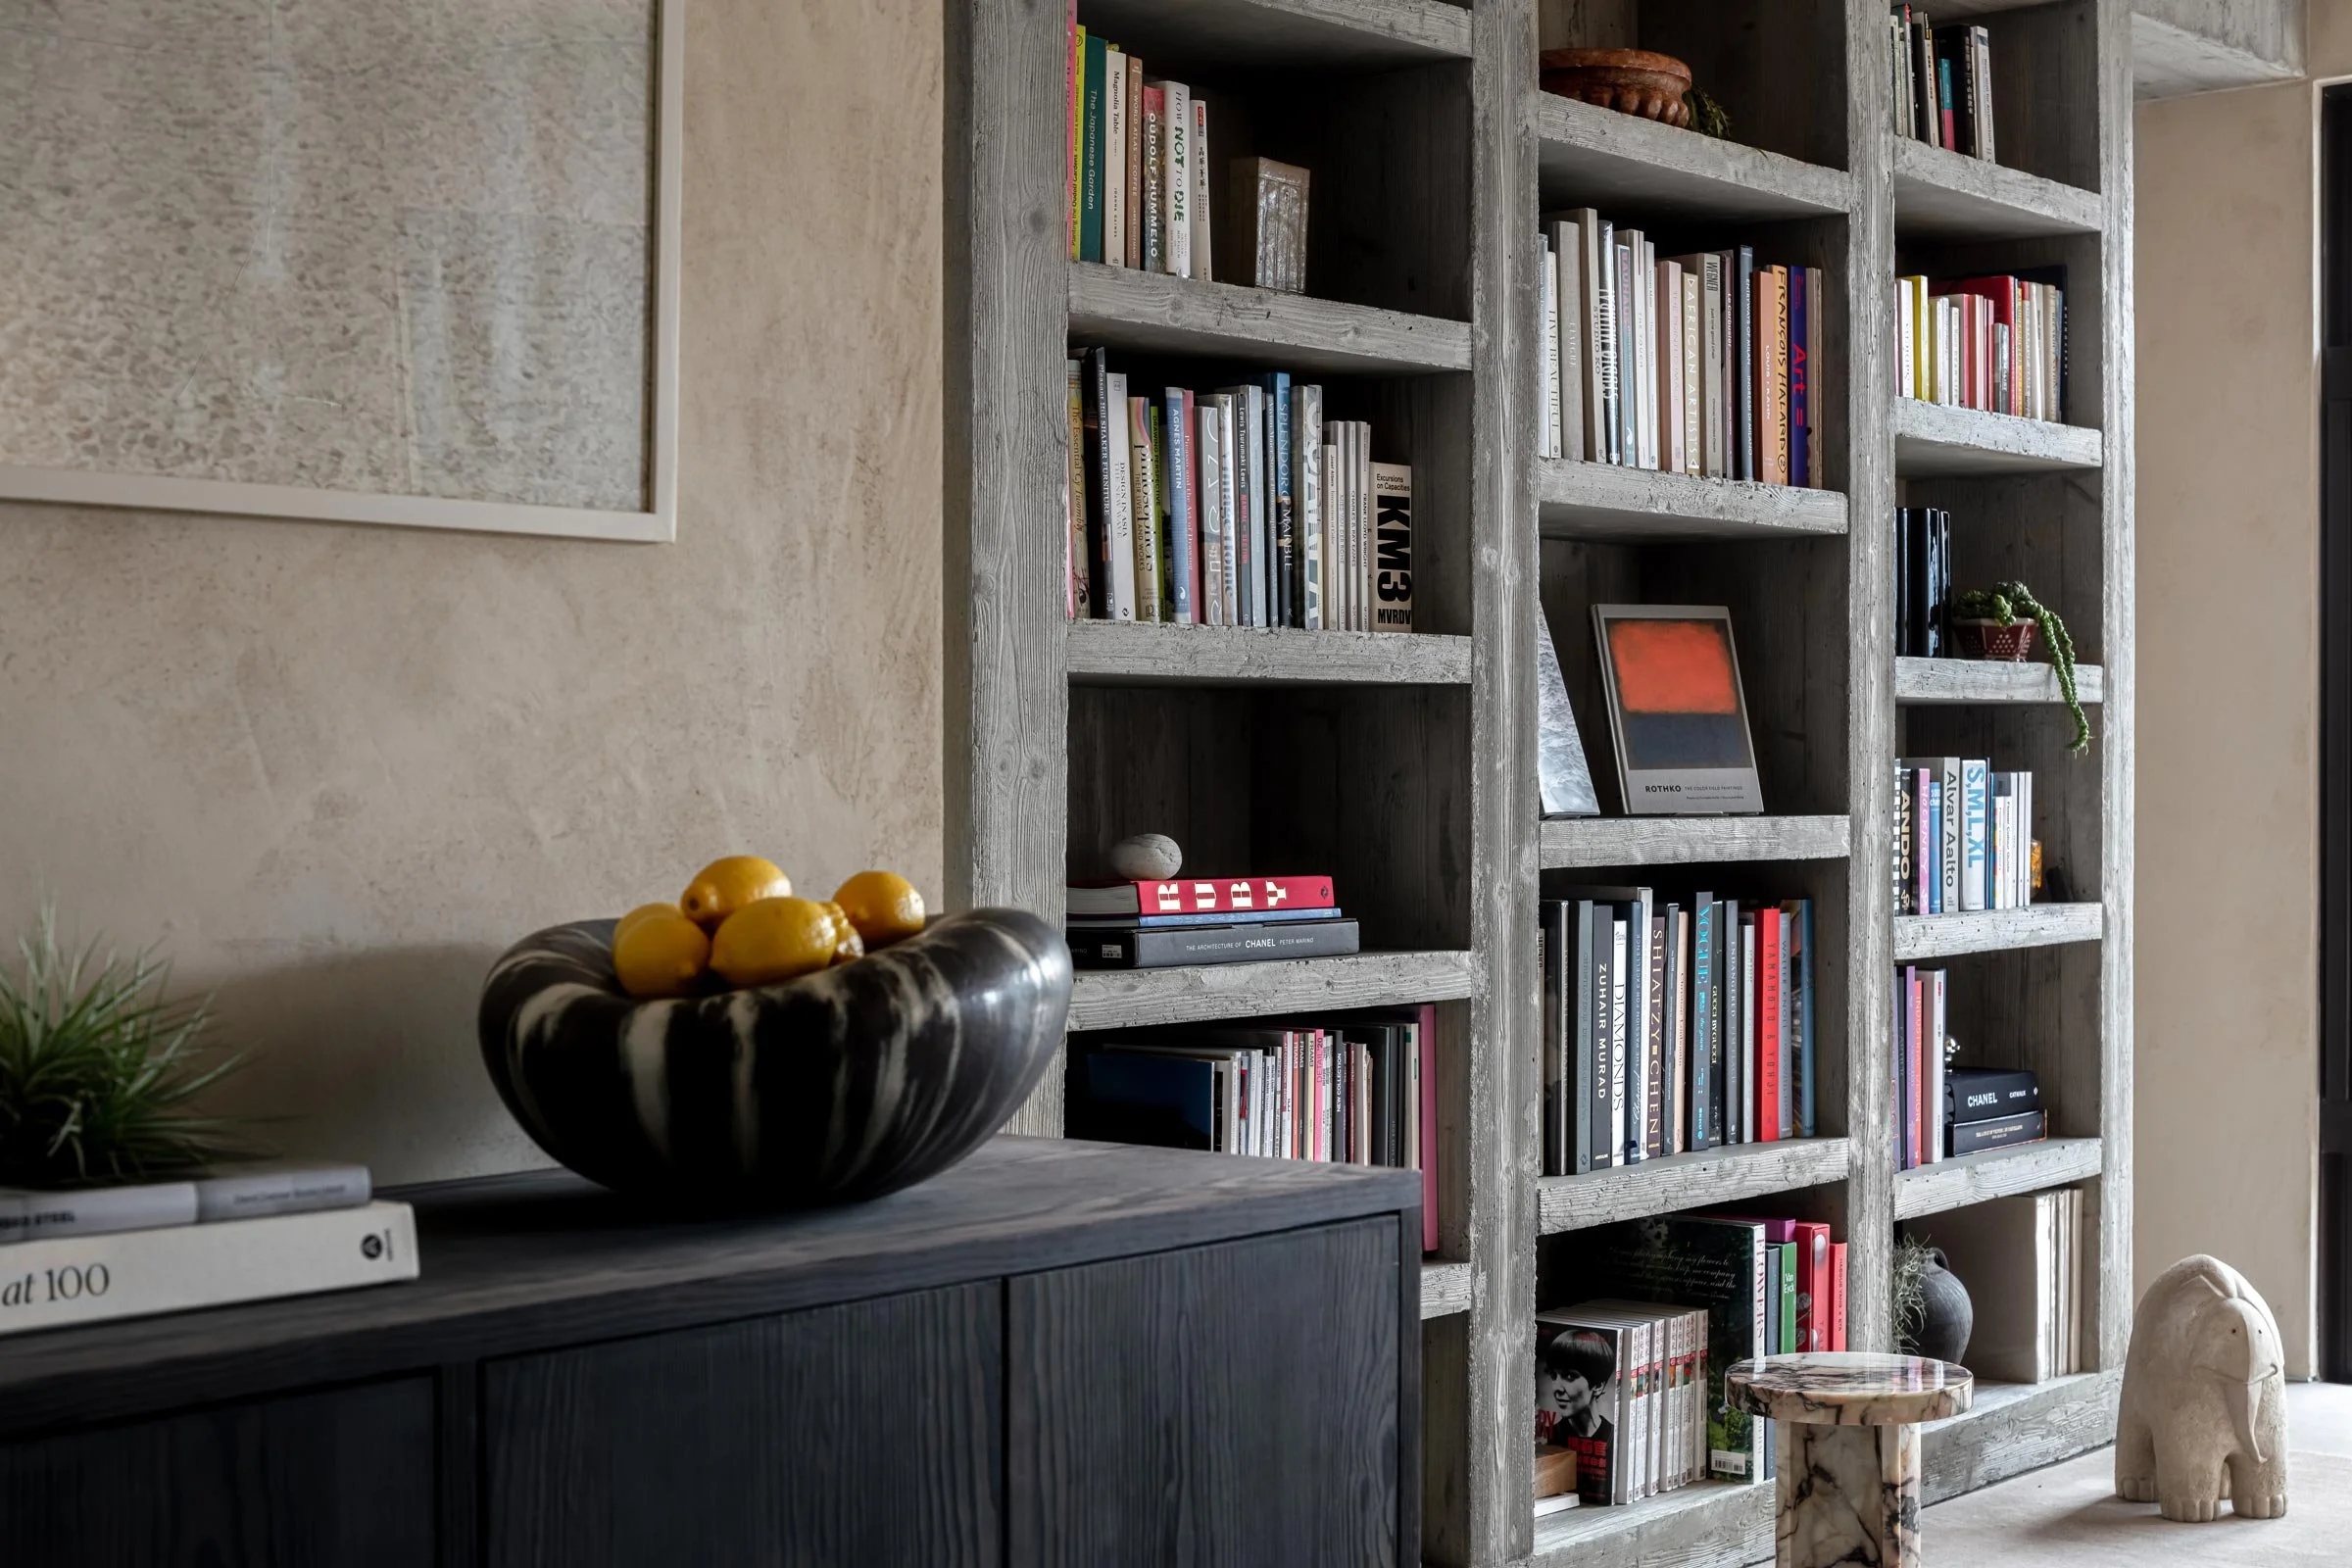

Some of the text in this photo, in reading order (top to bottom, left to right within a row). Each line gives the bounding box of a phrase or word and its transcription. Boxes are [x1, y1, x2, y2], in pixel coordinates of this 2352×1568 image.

[1088, 112, 1097, 166] Japanese
[1174, 126, 1184, 168] NOT
[1087, 170, 1096, 210] Garden
[1148, 113, 1158, 258] OUDOLF HUMMELO
[1175, 169, 1182, 187] TO
[1174, 190, 1184, 222] DIE
[1706, 261, 1718, 292] WEGNER
[1727, 293, 1732, 306] Le
[1746, 327, 1751, 338] OF
[1549, 310, 1560, 432] LIVE BEAUTIFUL
[1595, 357, 1601, 375] KO
[1686, 291, 1698, 454] AFRICAN ARTISTS
[1778, 270, 1786, 450] FRANÇOIS HALARD
[1792, 343, 1807, 396] Art
[1747, 413, 1752, 422] DI
[1073, 474, 1081, 486] Cy
[1279, 403, 1292, 571] SPLENDOR MARBLE
[1376, 473, 1404, 482] Excursions
[1385, 482, 1411, 492] Capacities
[1075, 489, 1083, 532] Twombly
[1121, 503, 1126, 513] IN
[1134, 444, 1156, 571] philosophers
[1377, 494, 1411, 602] KM3
[1377, 608, 1411, 625] MVRDV
[1901, 790, 1910, 880] ANDO
[1921, 785, 1929, 874] HOCKNEY
[1946, 771, 1957, 888] Alvar Aalto
[1965, 767, 1985, 868] S,M,L,XL
[1157, 880, 1287, 912] RUBY
[1197, 942, 1233, 951] ARCHITECTURE
[1245, 938, 1276, 949] CHANEL
[1697, 905, 1710, 984] VOGUE
[1767, 941, 1776, 1023] YAMAMOTO
[1597, 963, 1607, 1099] ZUHAIR MURAD
[1649, 929, 1663, 1134] SHIATZY CHEN
[1712, 1019, 1717, 1031] BY
[1613, 983, 1625, 1111] DIAMONDS
[1766, 1051, 1775, 1097] YOHJI
[2009, 1090, 2026, 1098] CATWALK
[1967, 1092, 1998, 1107] CHANEL
[1, 1262, 111, 1307] at 100
[1756, 1239, 1764, 1338] FLOWERS
[1783, 1283, 1795, 1294] Eyck
[1784, 1273, 1794, 1284] Van
